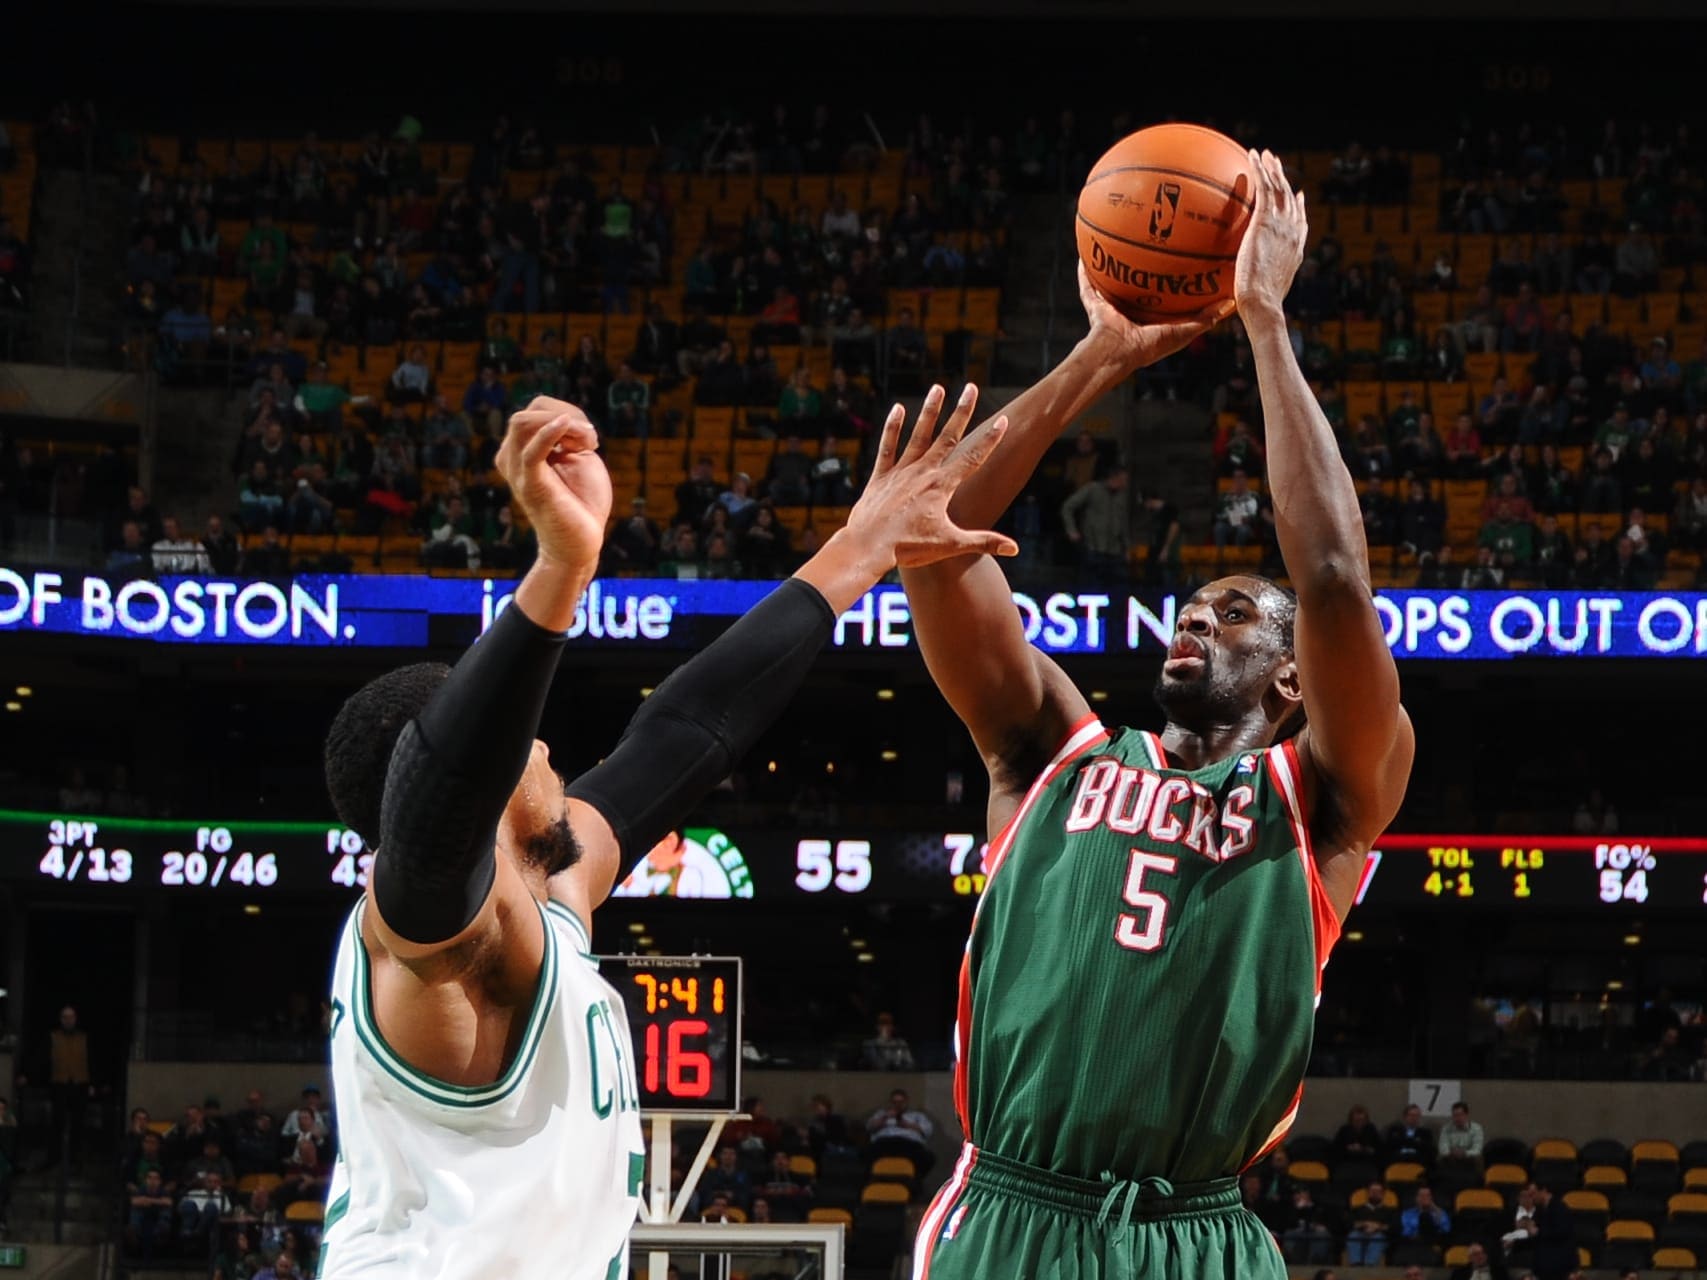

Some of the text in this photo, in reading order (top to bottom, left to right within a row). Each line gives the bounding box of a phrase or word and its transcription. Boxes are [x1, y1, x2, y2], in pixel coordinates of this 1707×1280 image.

[1091, 243, 1221, 297] SPALDING
[82, 577, 356, 639] BOSTON.
[1489, 596, 1623, 653] OUT
[1638, 597, 1707, 653] O
[1066, 756, 1256, 864] BUCKS
[48, 820, 98, 848] 3PT
[196, 827, 233, 853] FG
[943, 833, 988, 876] 7
[1428, 844, 1657, 871] TOL FLS FG%
[39, 846, 132, 883] 4/13
[161, 852, 278, 888] 20/46
[795, 840, 872, 893] 55
[953, 873, 987, 895] QT
[1514, 873, 1531, 897] 1
[1600, 869, 1649, 903] 54
[1114, 848, 1178, 954] 5
[635, 974, 725, 1014] 7:41
[645, 1020, 712, 1098] 16
[1425, 1084, 1442, 1112] 7
